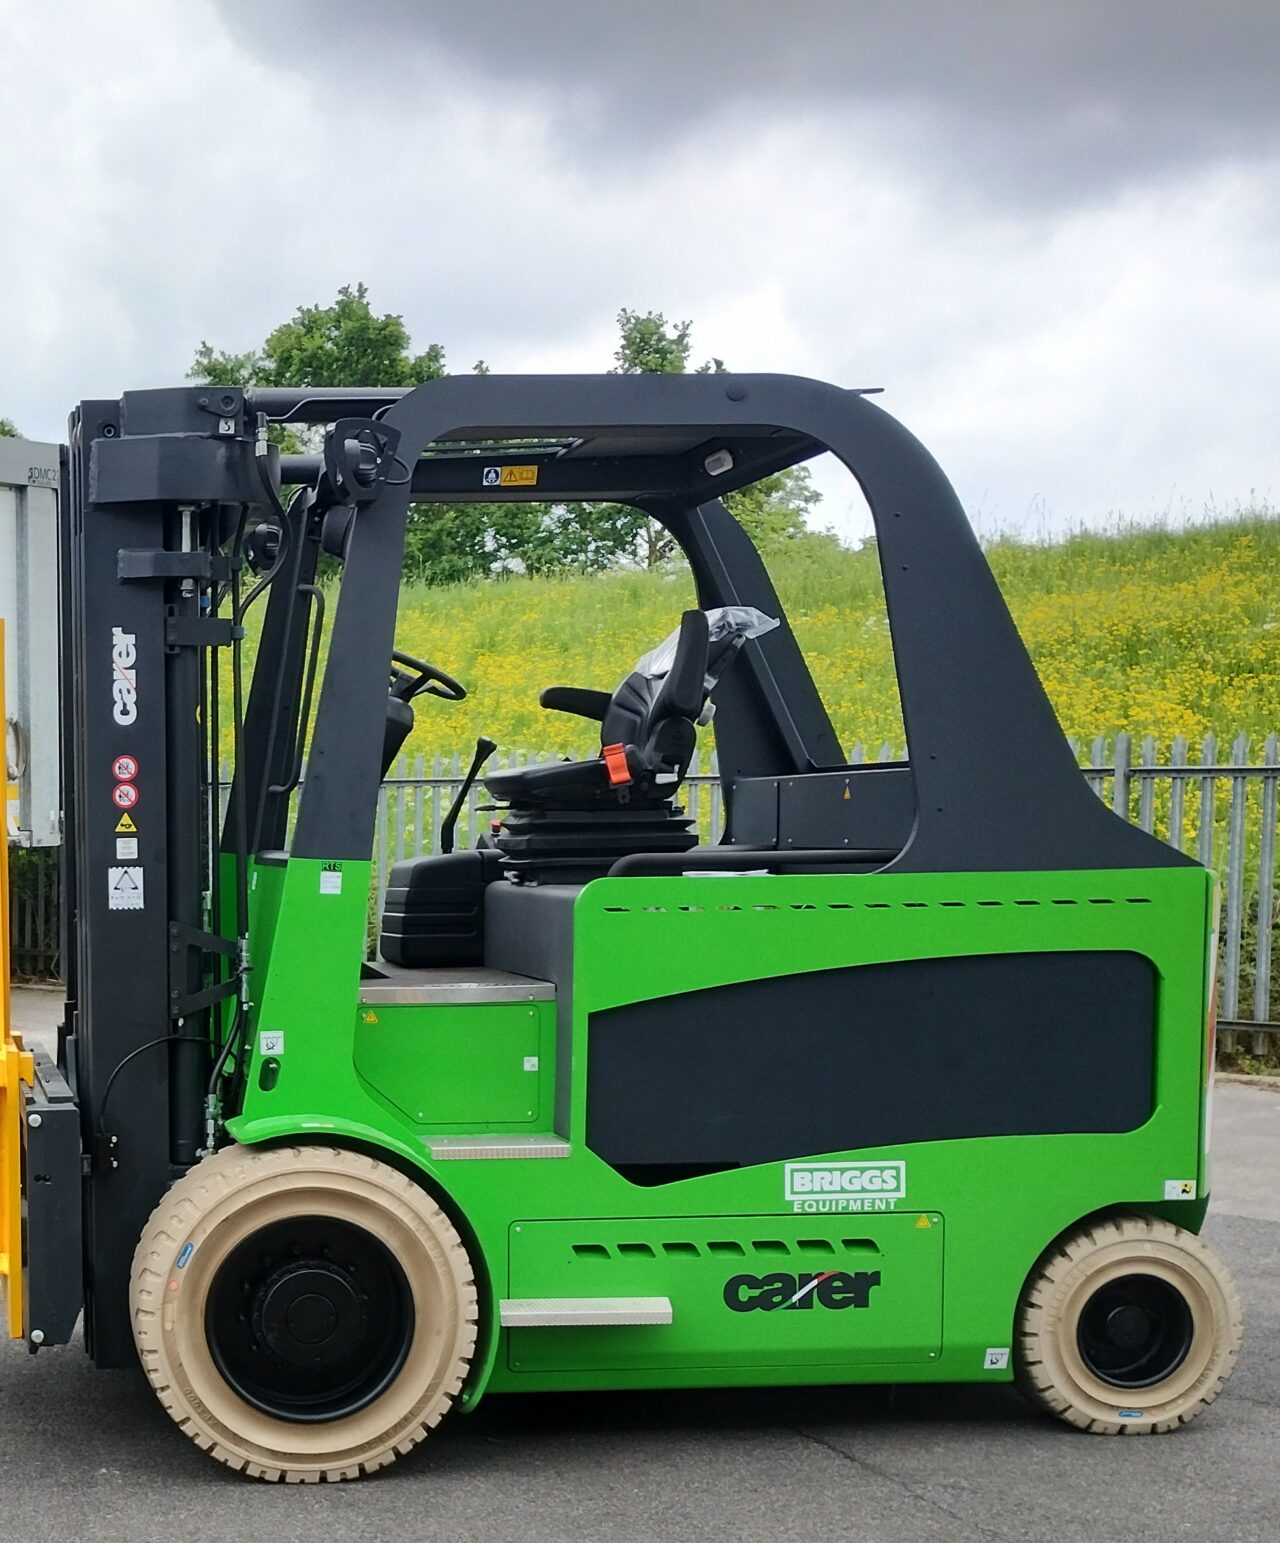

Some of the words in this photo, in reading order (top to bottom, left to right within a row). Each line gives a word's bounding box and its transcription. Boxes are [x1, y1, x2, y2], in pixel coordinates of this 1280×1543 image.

[112, 627, 137, 725] carer
[793, 1169, 897, 1192] BRIGGS
[793, 1198, 898, 1212] EQUIPMENT
[723, 1270, 881, 1312] carer
